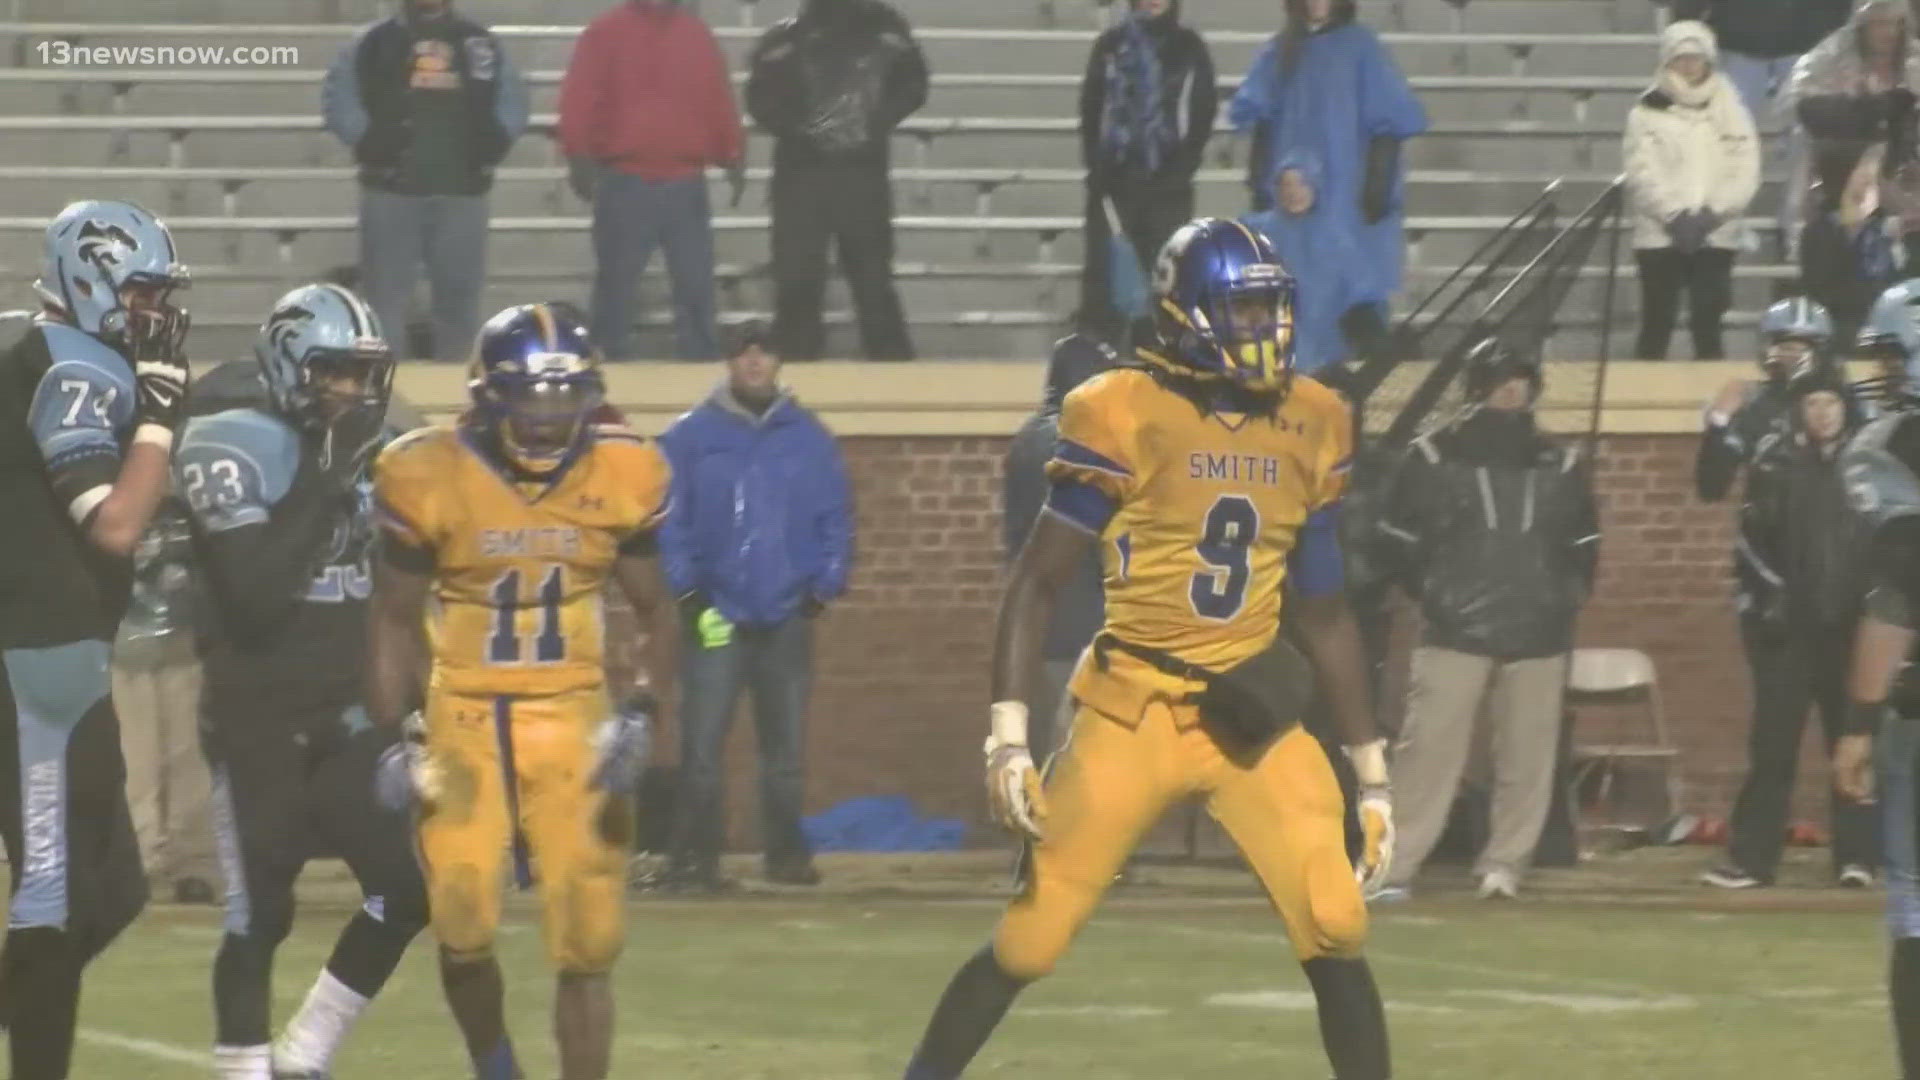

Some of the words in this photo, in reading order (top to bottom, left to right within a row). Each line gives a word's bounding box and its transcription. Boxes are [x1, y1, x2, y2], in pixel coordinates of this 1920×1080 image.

[182, 458, 244, 512] 23
[1189, 452, 1278, 485] SMITH
[480, 527, 583, 559] SMITH
[1187, 492, 1262, 623] 9
[482, 563, 569, 667] 11
